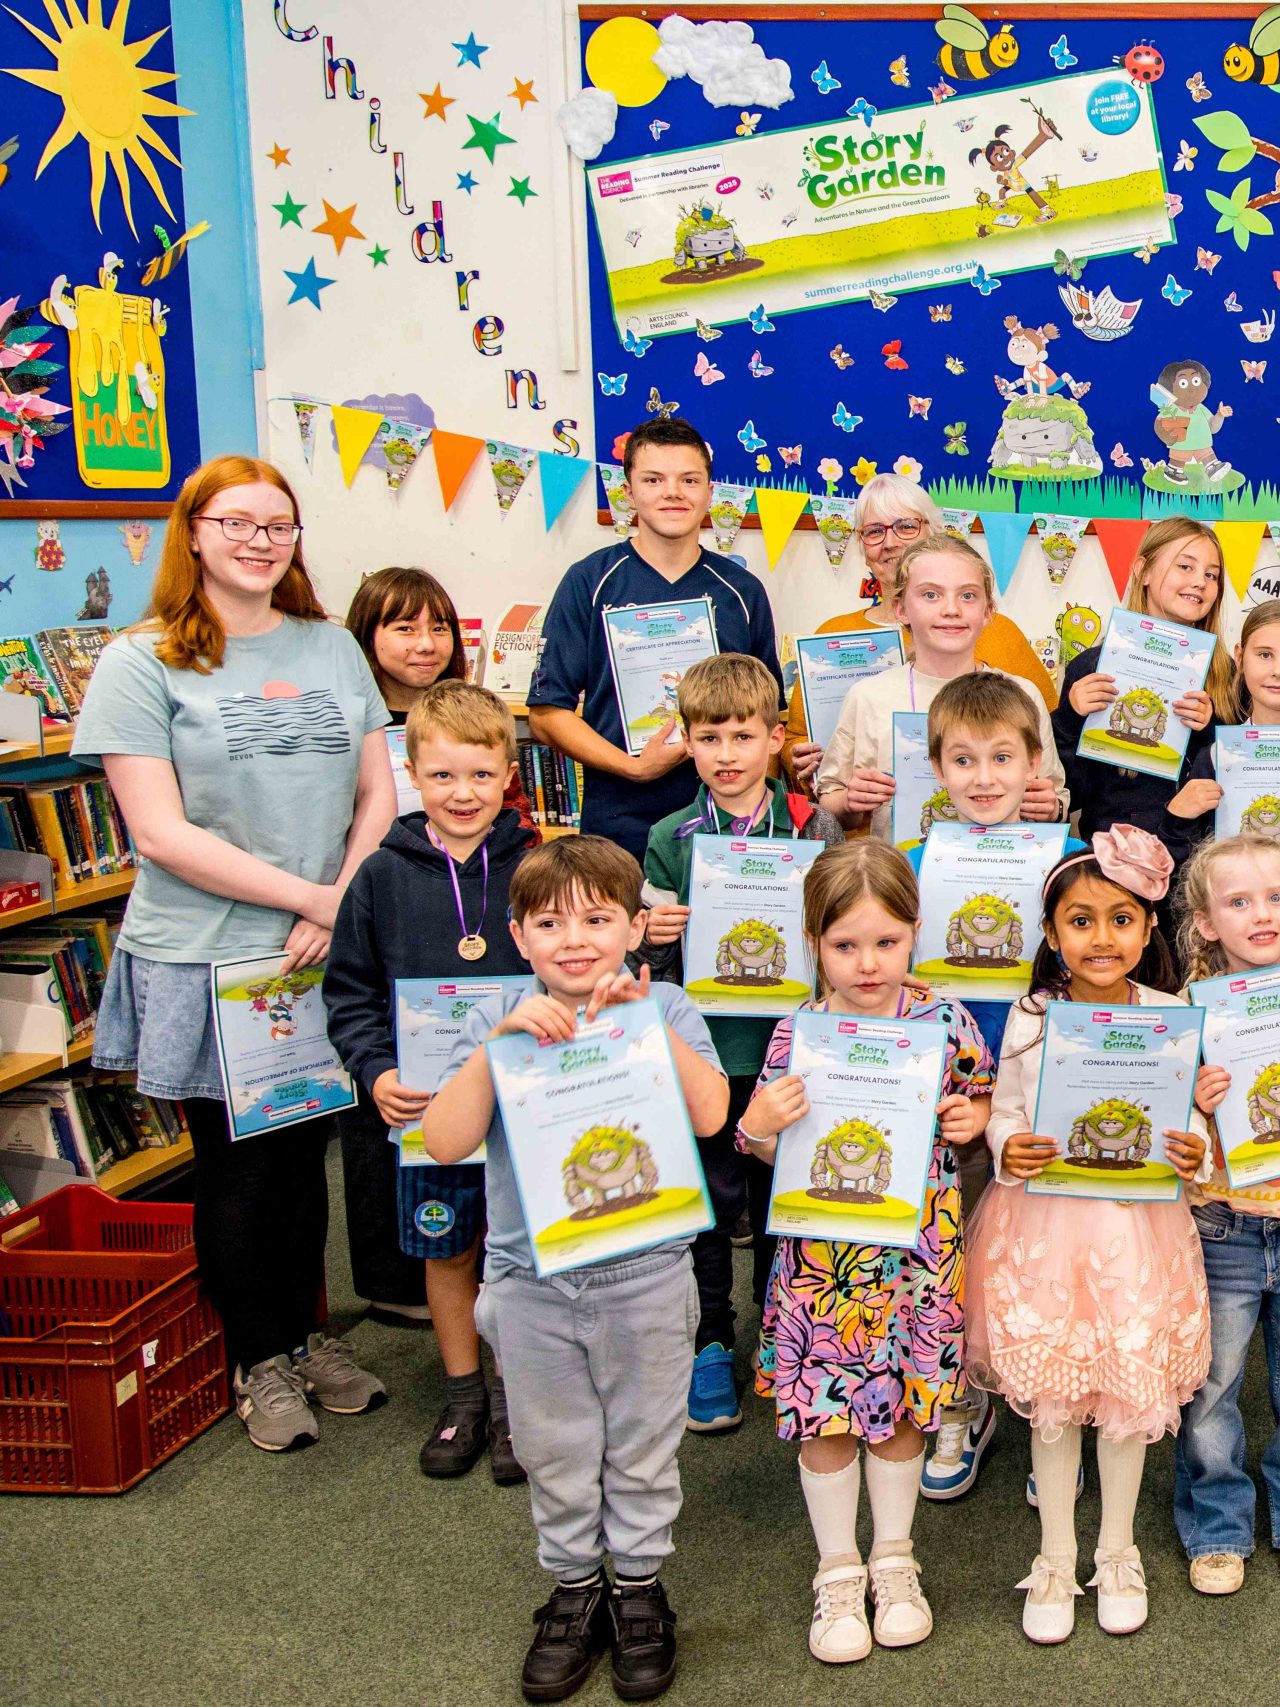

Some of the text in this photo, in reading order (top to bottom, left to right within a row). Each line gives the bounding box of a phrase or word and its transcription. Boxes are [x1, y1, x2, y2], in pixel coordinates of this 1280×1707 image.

[1095, 92, 1129, 106] Join FREE
[1091, 102, 1136, 115] at your local
[1101, 113, 1129, 123] library!
[814, 131, 924, 171] Story
[634, 162, 720, 183] Summer Reading Challenge
[601, 178, 630, 188] READING
[719, 180, 738, 192] 2025
[807, 162, 945, 209] Garden
[620, 194, 642, 204] Delivered
[689, 183, 709, 191] libraries
[814, 212, 848, 223] Adventures
[855, 207, 876, 215] Nature
[903, 199, 920, 207] Great
[921, 194, 950, 205] Outdoors
[804, 260, 978, 298] summerreadingchallenge.org.uk
[649, 312, 689, 323] ARTS COUNCIL
[650, 320, 677, 329] ENGLAND
[81, 402, 158, 450] HONEY
[62, 637, 81, 647] THE
[496, 633, 535, 642] DESIGN FOR
[1149, 637, 1172, 649] Story
[494, 642, 532, 651] FICTION
[626, 644, 656, 652] CERTIFICATE
[666, 639, 700, 647] APPRECIATION
[1144, 643, 1173, 656] Garden
[1128, 654, 1180, 672] CONGRATULATIONS!
[817, 673, 847, 682] CERTIFICATE
[230, 752, 254, 761] DEVON
[744, 859, 773, 869] Story
[957, 857, 1026, 865] CONGRATULATIONS!
[741, 867, 777, 876] Garden
[724, 884, 789, 892] CONGRATULATIONS!
[1249, 994, 1279, 1008] Story
[1109, 1031, 1143, 1042] Story
[854, 1043, 887, 1056] Story
[1103, 1040, 1146, 1051] Garden
[848, 1053, 889, 1066] Garden
[1082, 1059, 1159, 1067] CONGRATULATIONS!
[828, 1073, 901, 1086] CONGRATULATIONS!
